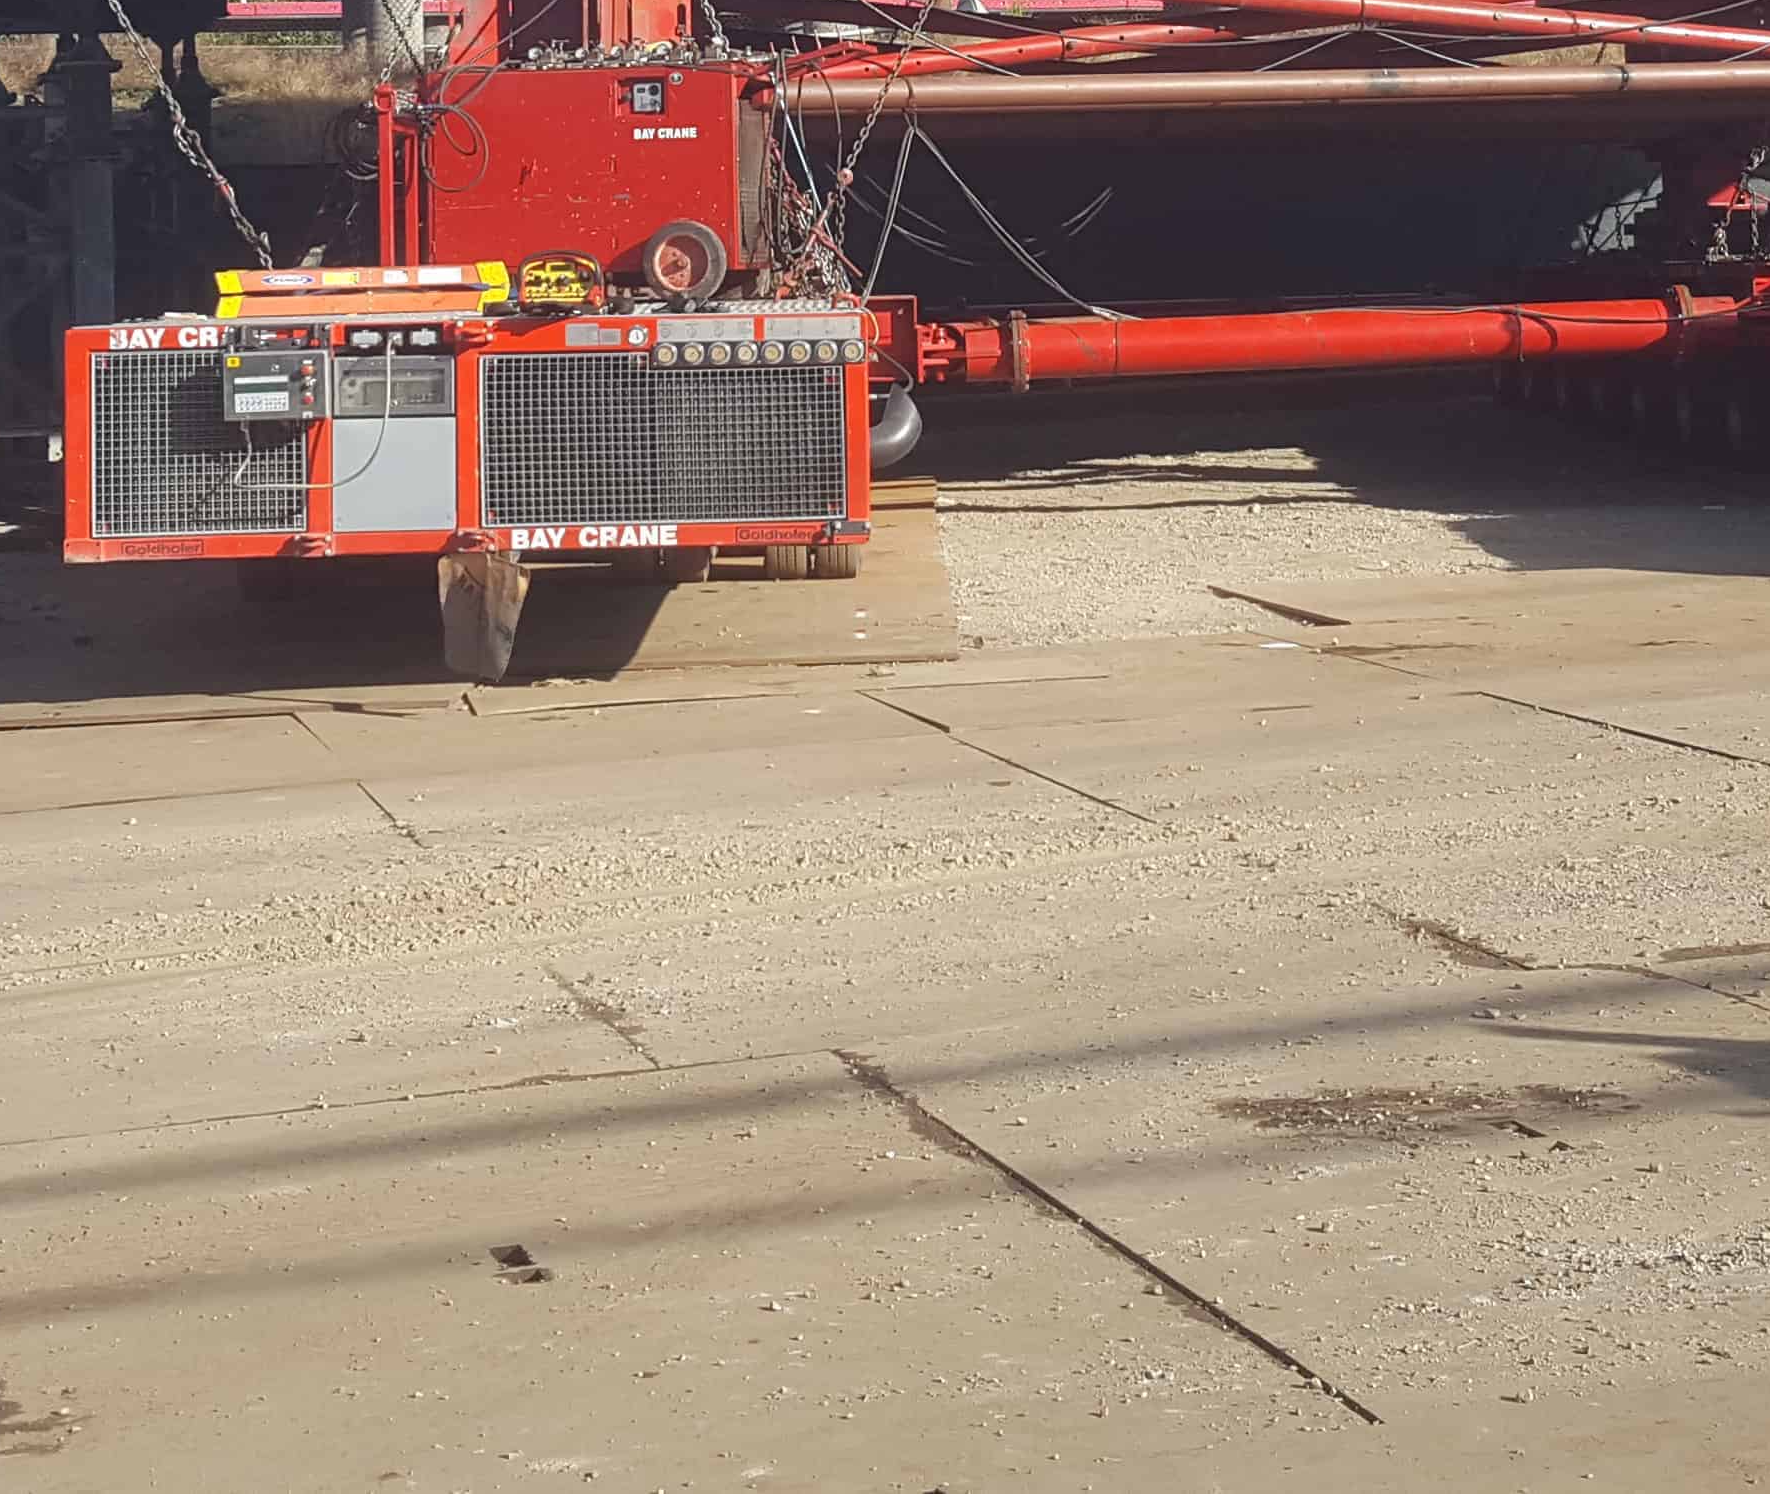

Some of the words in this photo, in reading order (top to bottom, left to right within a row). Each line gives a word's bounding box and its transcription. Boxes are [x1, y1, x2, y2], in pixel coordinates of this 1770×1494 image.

[633, 127, 656, 140] BAY
[657, 126, 698, 139] CRANE
[109, 328, 166, 350] BAY
[511, 527, 566, 550] BAY
[579, 524, 678, 548] CRANE
